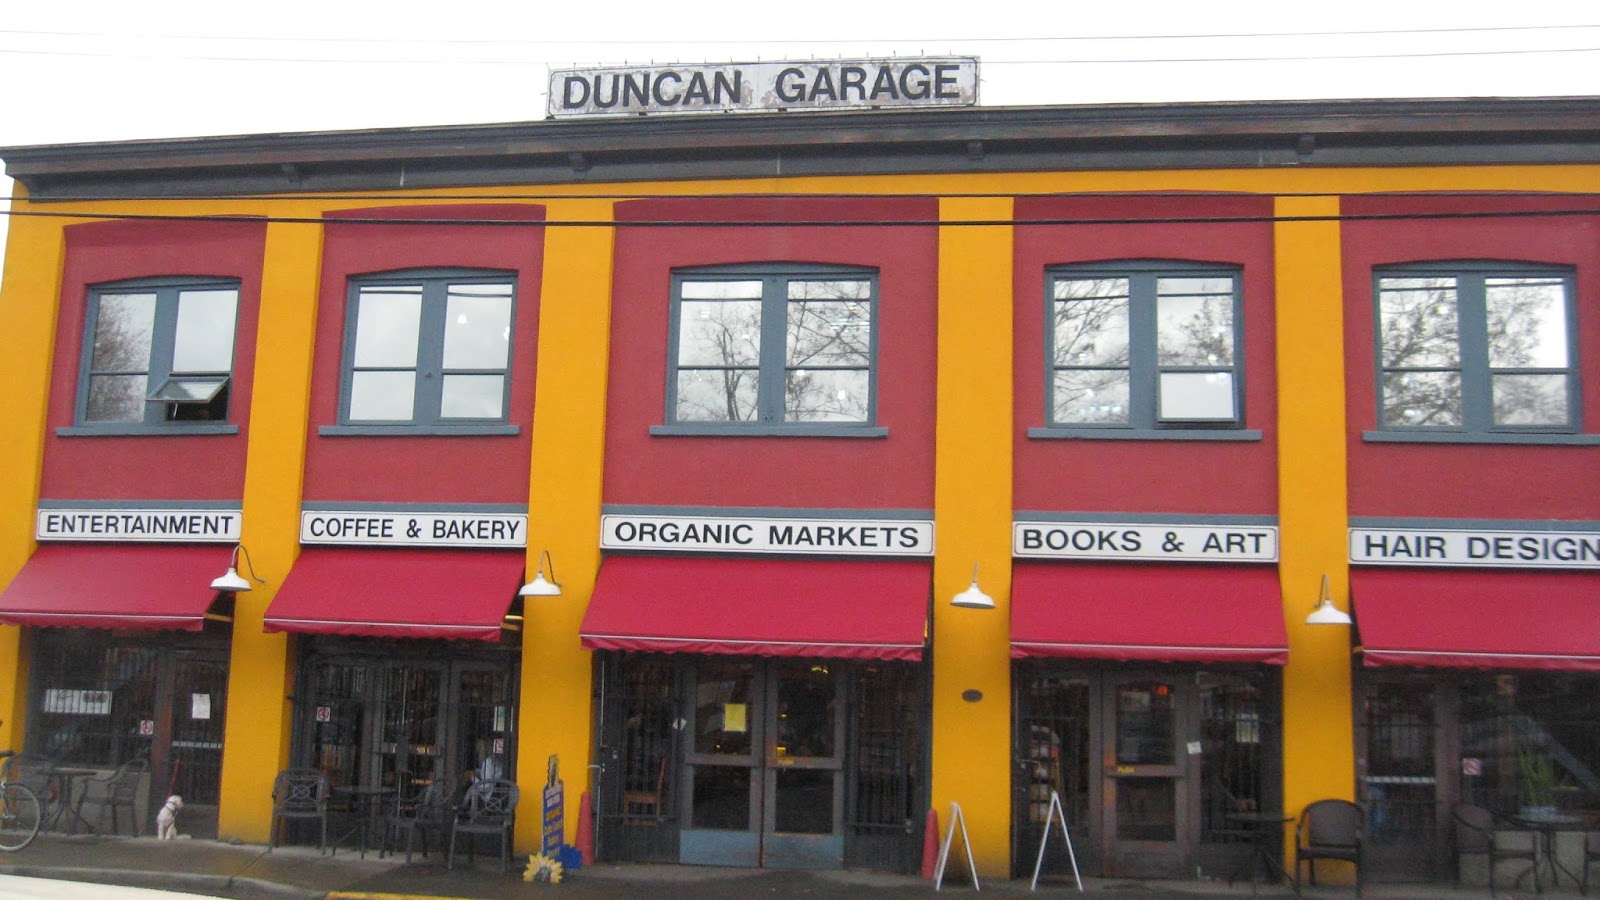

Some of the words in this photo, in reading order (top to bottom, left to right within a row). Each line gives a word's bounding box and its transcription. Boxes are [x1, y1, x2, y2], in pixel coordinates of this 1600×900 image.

[563, 71, 742, 109] DUNCAN
[775, 65, 961, 102] GARAGE
[47, 515, 234, 535] ENTERTAINMENT
[309, 518, 394, 538] COFFEE
[406, 523, 421, 538] &
[433, 520, 520, 540] BAKERY
[614, 521, 753, 545] ORGANIC
[768, 525, 919, 548] MARKETS
[1022, 529, 1142, 553] BOOKS
[1161, 531, 1184, 553] &
[1201, 532, 1268, 554] ART
[1365, 535, 1447, 559] HAIR
[1467, 535, 1600, 561] DESIGN
